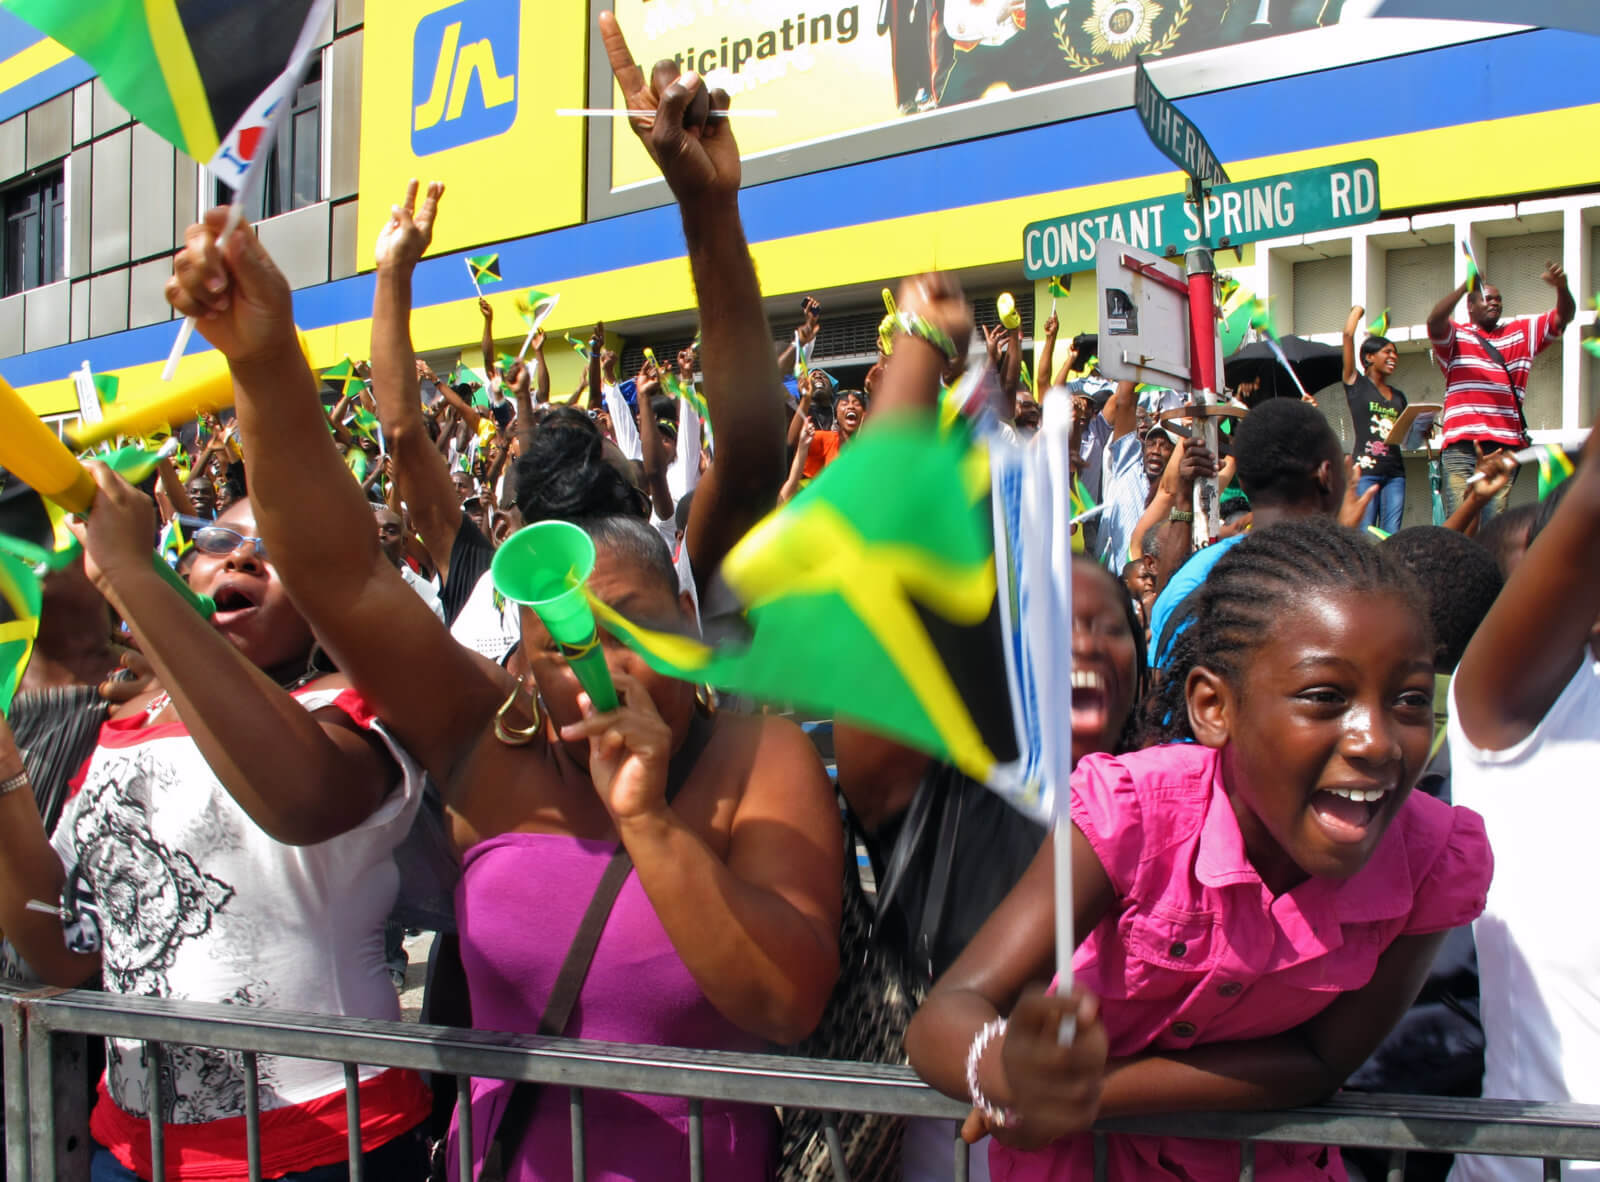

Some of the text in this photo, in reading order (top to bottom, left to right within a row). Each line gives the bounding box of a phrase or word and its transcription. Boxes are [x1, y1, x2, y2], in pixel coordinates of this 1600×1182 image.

[674, 5, 859, 76] ticipating
[1026, 168, 1375, 270] CONSTANT SPRING RD
